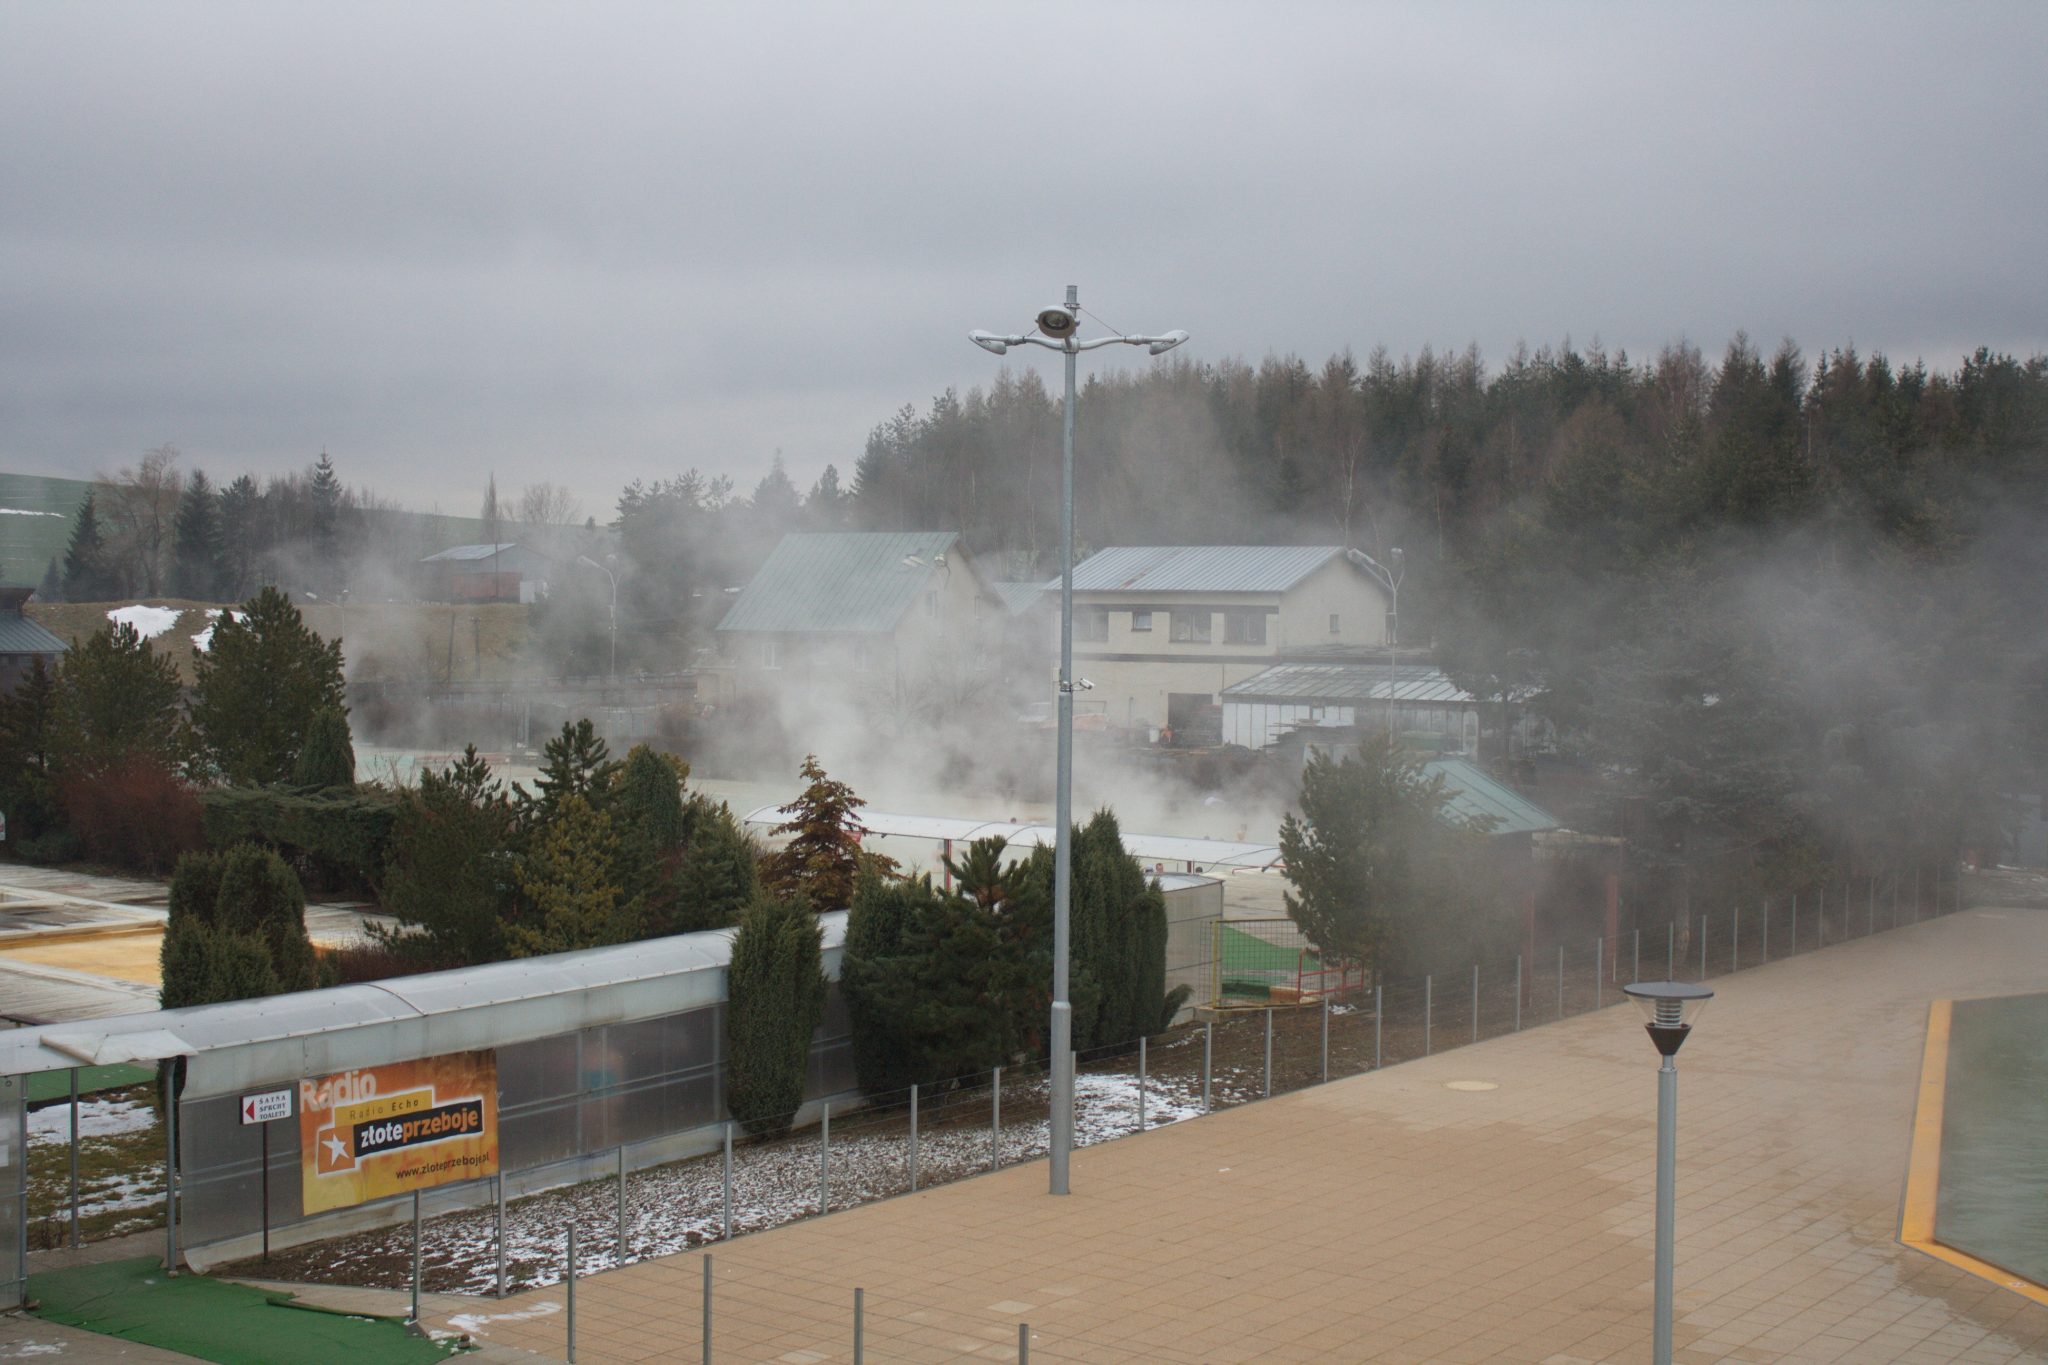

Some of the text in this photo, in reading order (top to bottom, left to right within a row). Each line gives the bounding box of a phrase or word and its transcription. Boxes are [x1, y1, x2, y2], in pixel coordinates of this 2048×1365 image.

[299, 1070, 377, 1113] Radio
[259, 1102, 287, 1112] SPRCHY
[350, 1099, 419, 1119] Radio Echo
[260, 1110, 286, 1120] TOALETY
